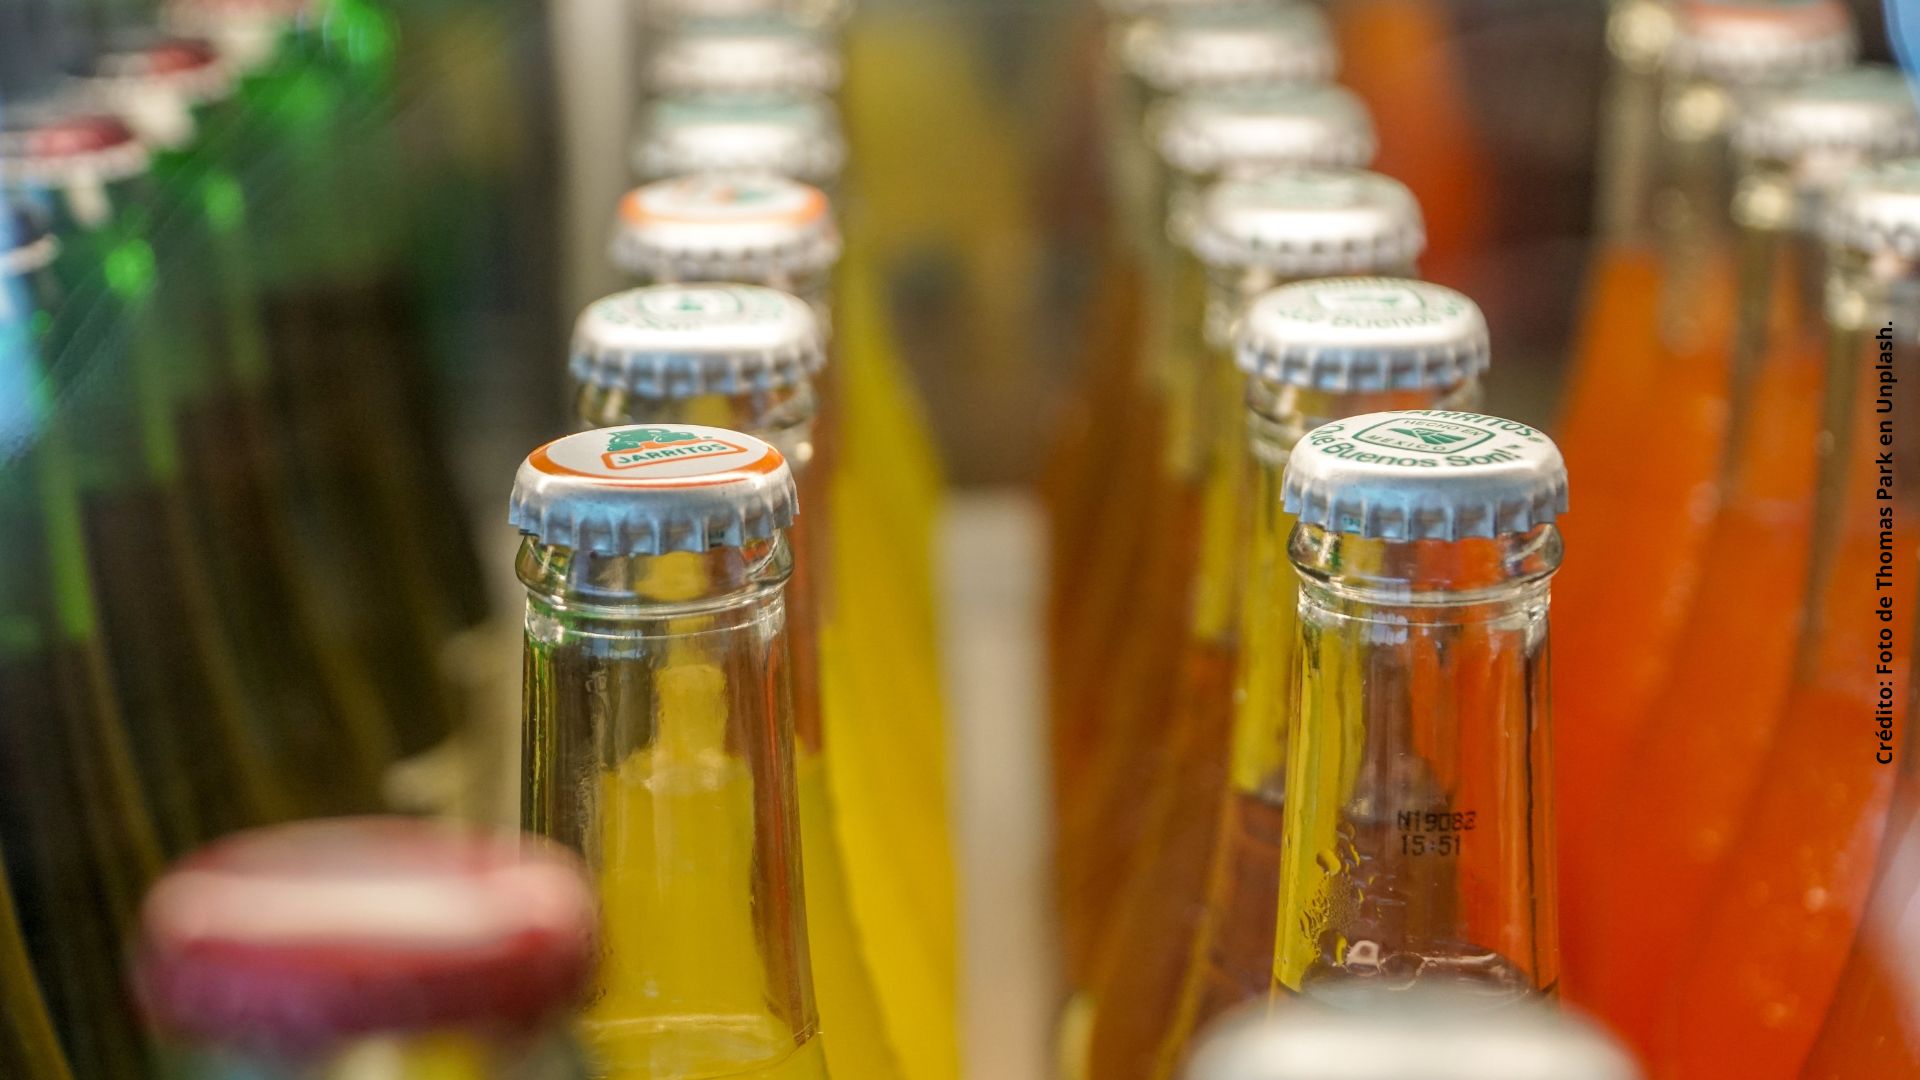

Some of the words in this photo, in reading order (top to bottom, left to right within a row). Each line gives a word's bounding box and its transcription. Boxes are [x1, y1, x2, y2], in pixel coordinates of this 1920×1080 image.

[1391, 411, 1540, 437] ARRITOS
[1404, 420, 1459, 431] HECHO
[1461, 428, 1484, 436] EN
[618, 443, 727, 464] JARRITOS
[1366, 434, 1447, 451] MEXICO
[1322, 442, 1438, 468] Buenos
[1401, 834, 1461, 857] 15:51
